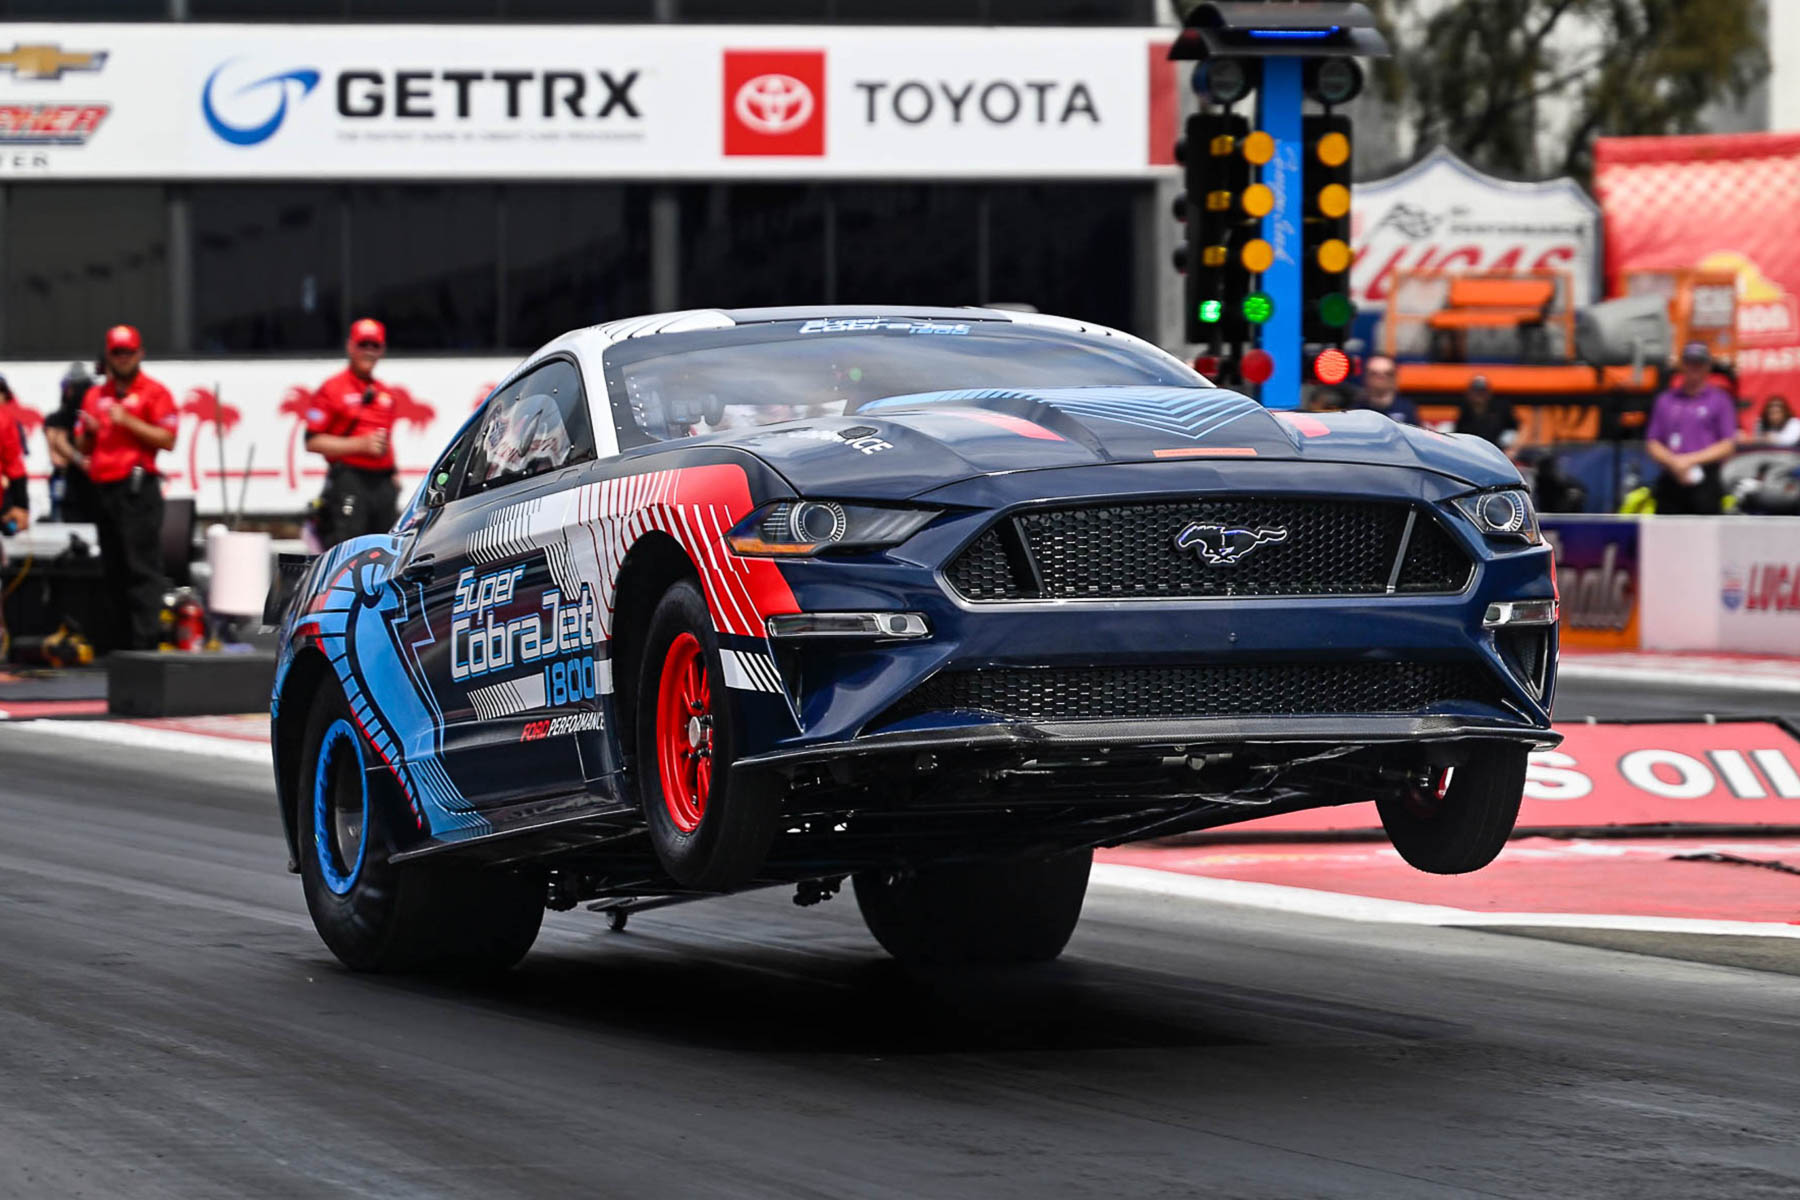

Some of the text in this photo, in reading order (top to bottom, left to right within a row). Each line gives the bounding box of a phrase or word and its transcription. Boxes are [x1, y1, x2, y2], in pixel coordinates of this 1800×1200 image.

[336, 71, 641, 118] GETTRX
[854, 81, 1101, 124] TOYOTA
[453, 564, 527, 625] Super
[544, 656, 596, 708] 1800
[520, 719, 550, 742] FORD
